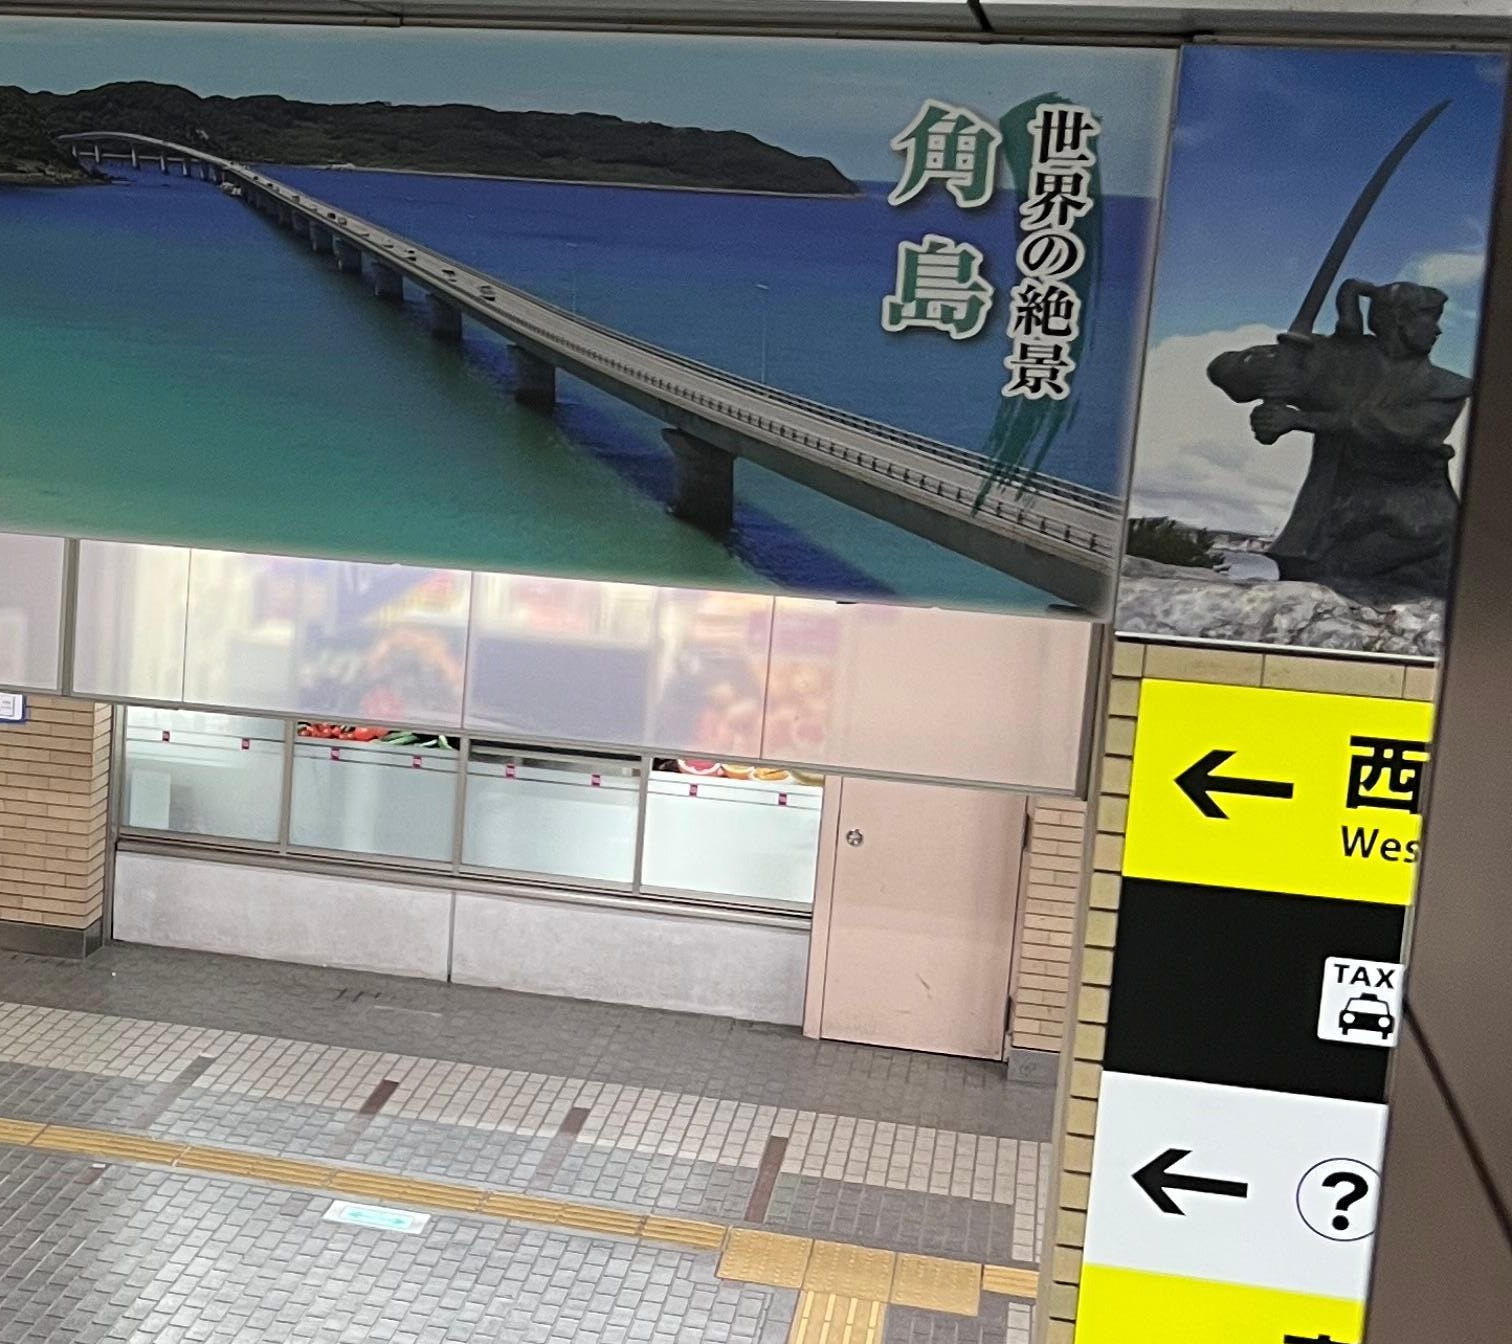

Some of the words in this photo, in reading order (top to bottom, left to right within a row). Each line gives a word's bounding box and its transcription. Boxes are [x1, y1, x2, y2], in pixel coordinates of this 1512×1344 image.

[883, 99, 1002, 340] 角島
[1002, 105, 1101, 400] 世界の絶景
[1333, 963, 1396, 990] TAX
